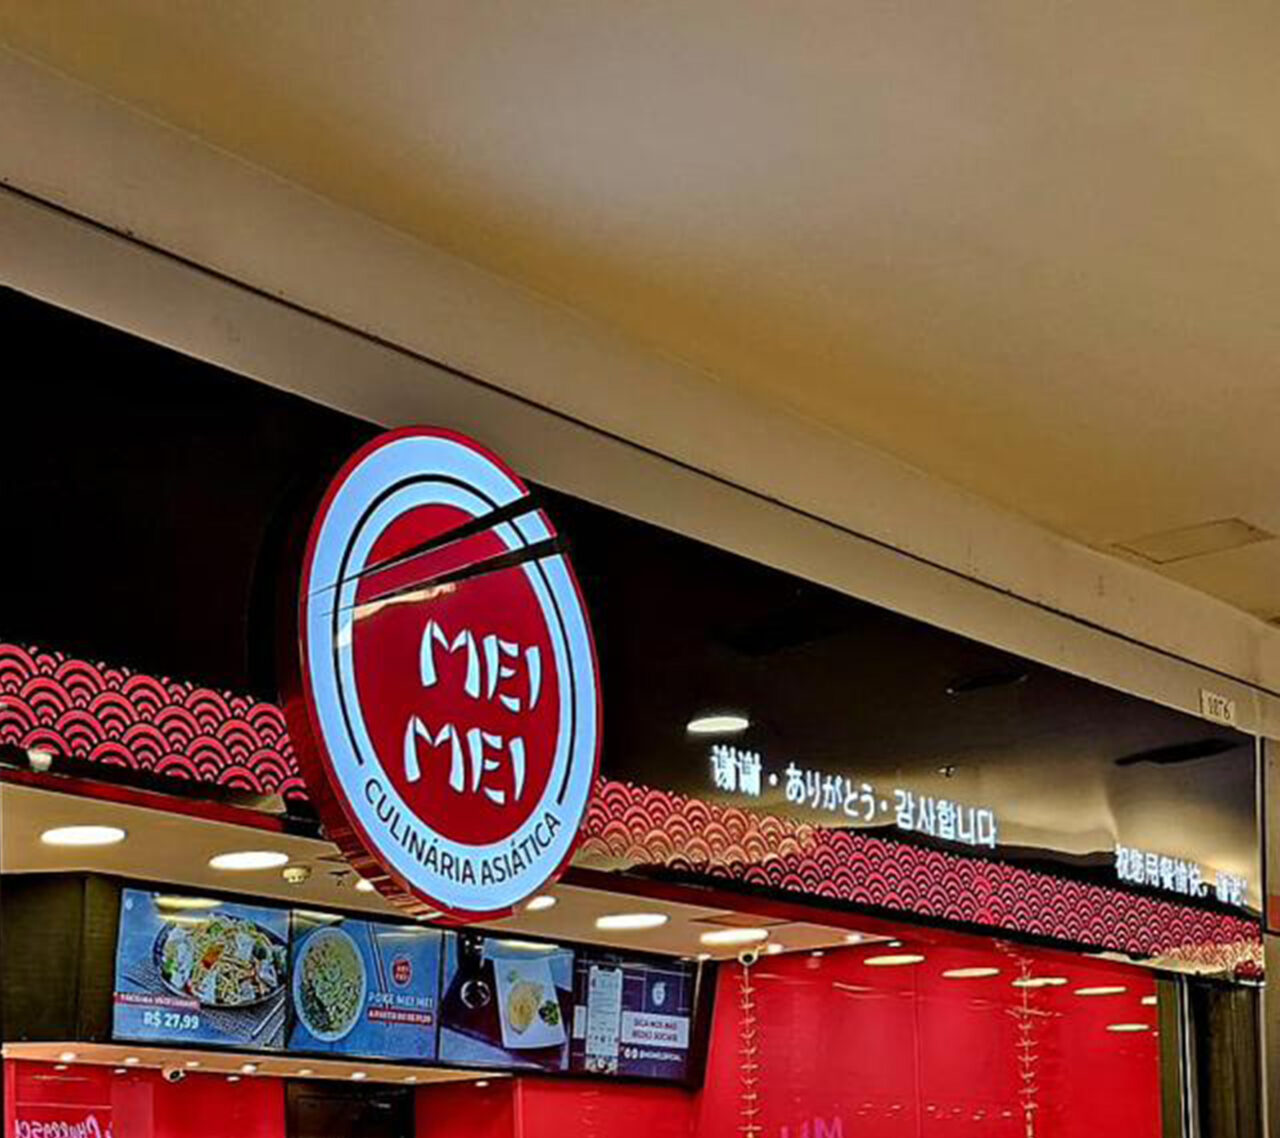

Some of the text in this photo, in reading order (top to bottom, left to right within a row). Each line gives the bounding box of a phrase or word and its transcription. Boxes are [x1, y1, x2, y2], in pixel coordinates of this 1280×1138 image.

[419, 618, 542, 712] MEI
[403, 714, 526, 806] MEI
[786, 762, 875, 821] ありがとう
[894, 788, 996, 849] 감사합니다
[364, 778, 561, 886] CULINÁRIA ASIÁTICA
[143, 1011, 200, 1030] R$ 27,99
